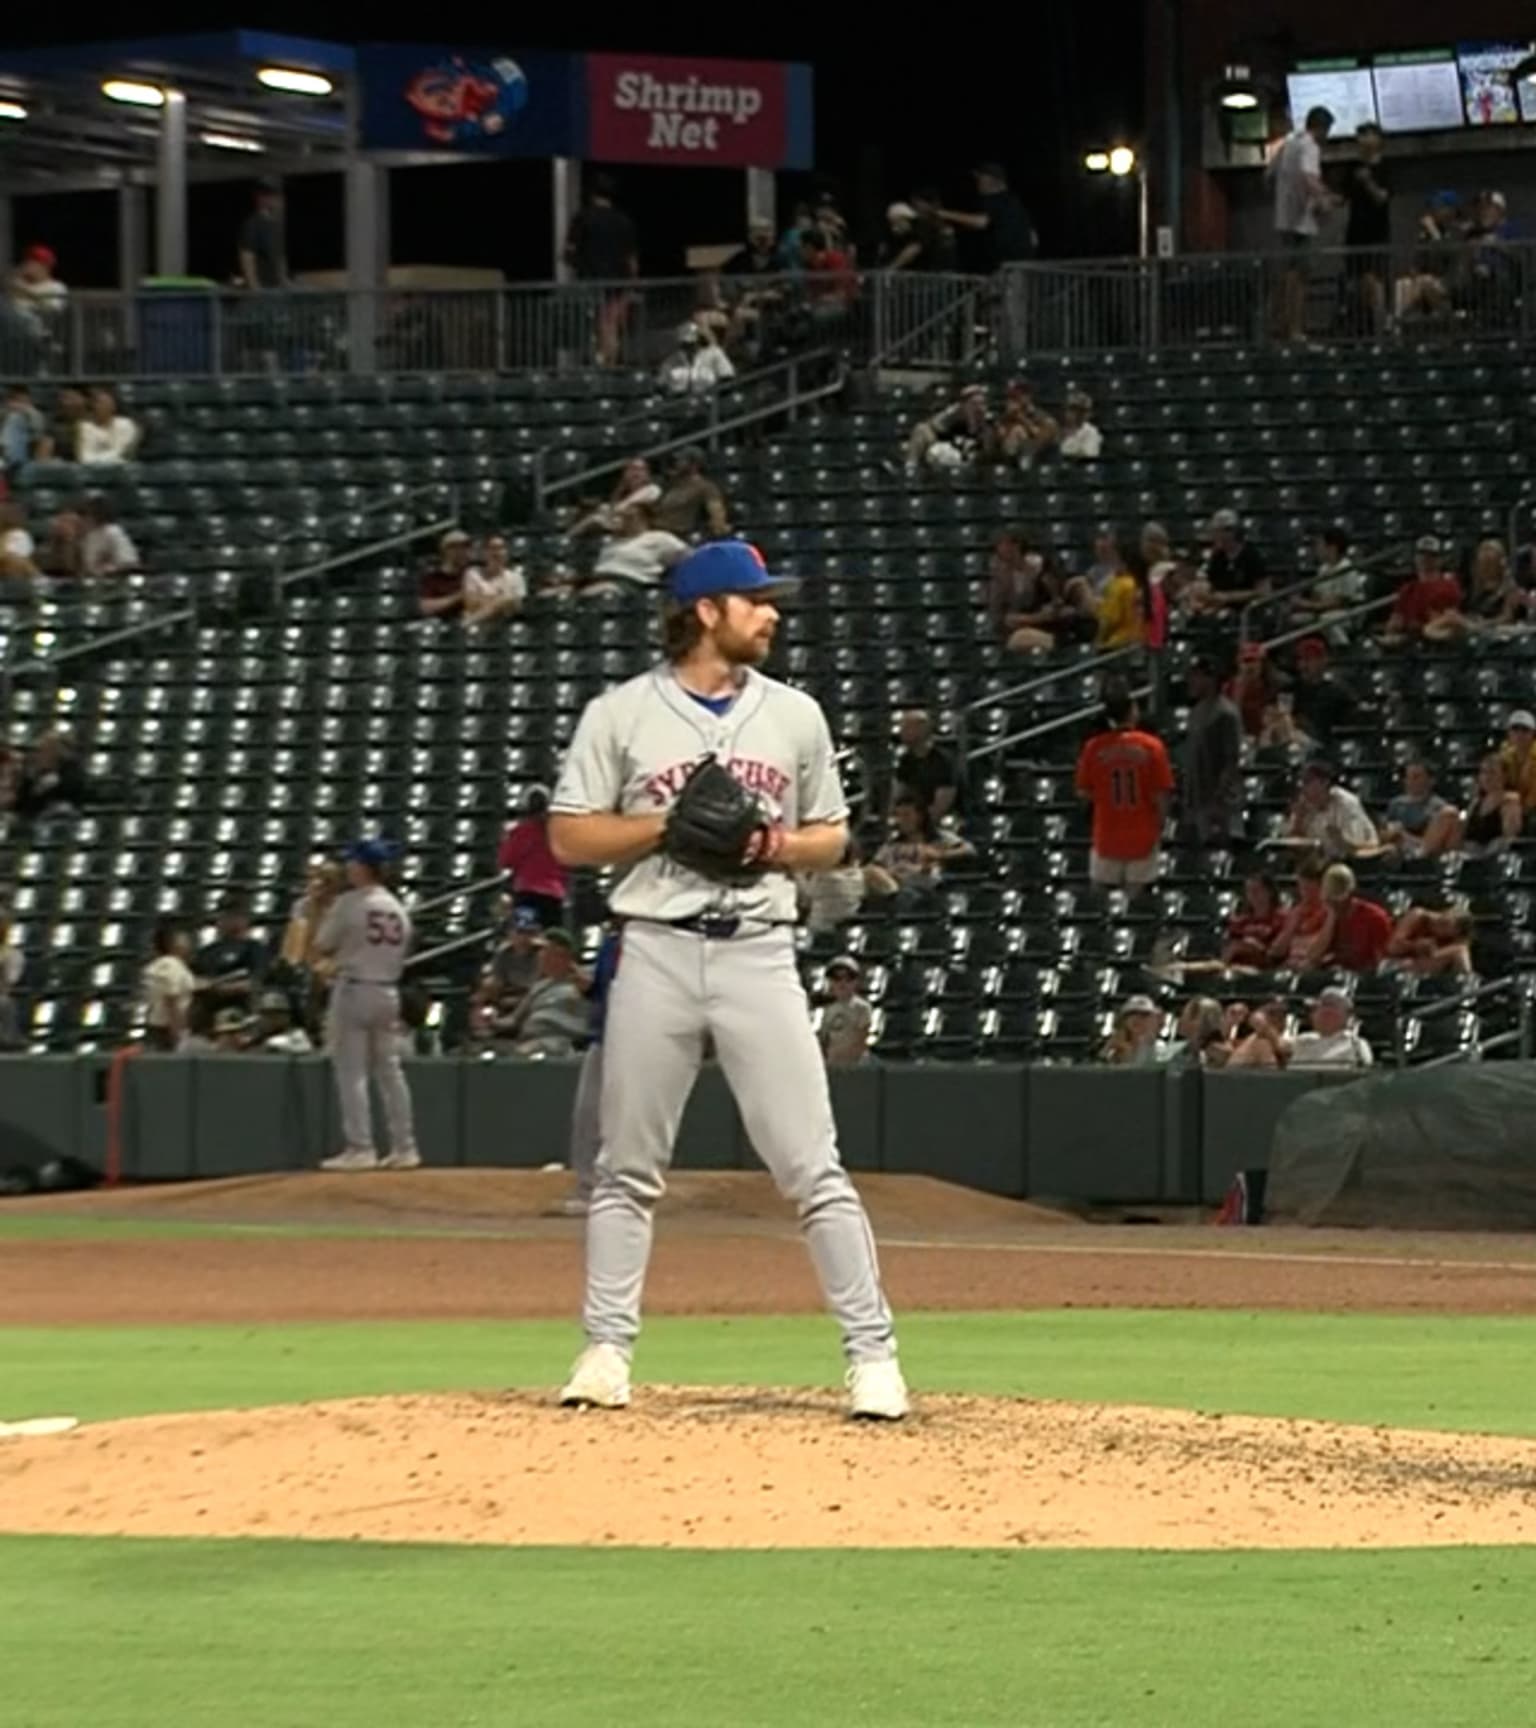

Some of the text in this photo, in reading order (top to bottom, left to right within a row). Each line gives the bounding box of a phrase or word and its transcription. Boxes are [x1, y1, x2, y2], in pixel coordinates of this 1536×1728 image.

[614, 71, 762, 123] Shrimp
[648, 112, 718, 149] Net
[646, 757, 790, 806] SYRCUSE
[1112, 768, 1139, 808] 11
[366, 910, 403, 946] 53
